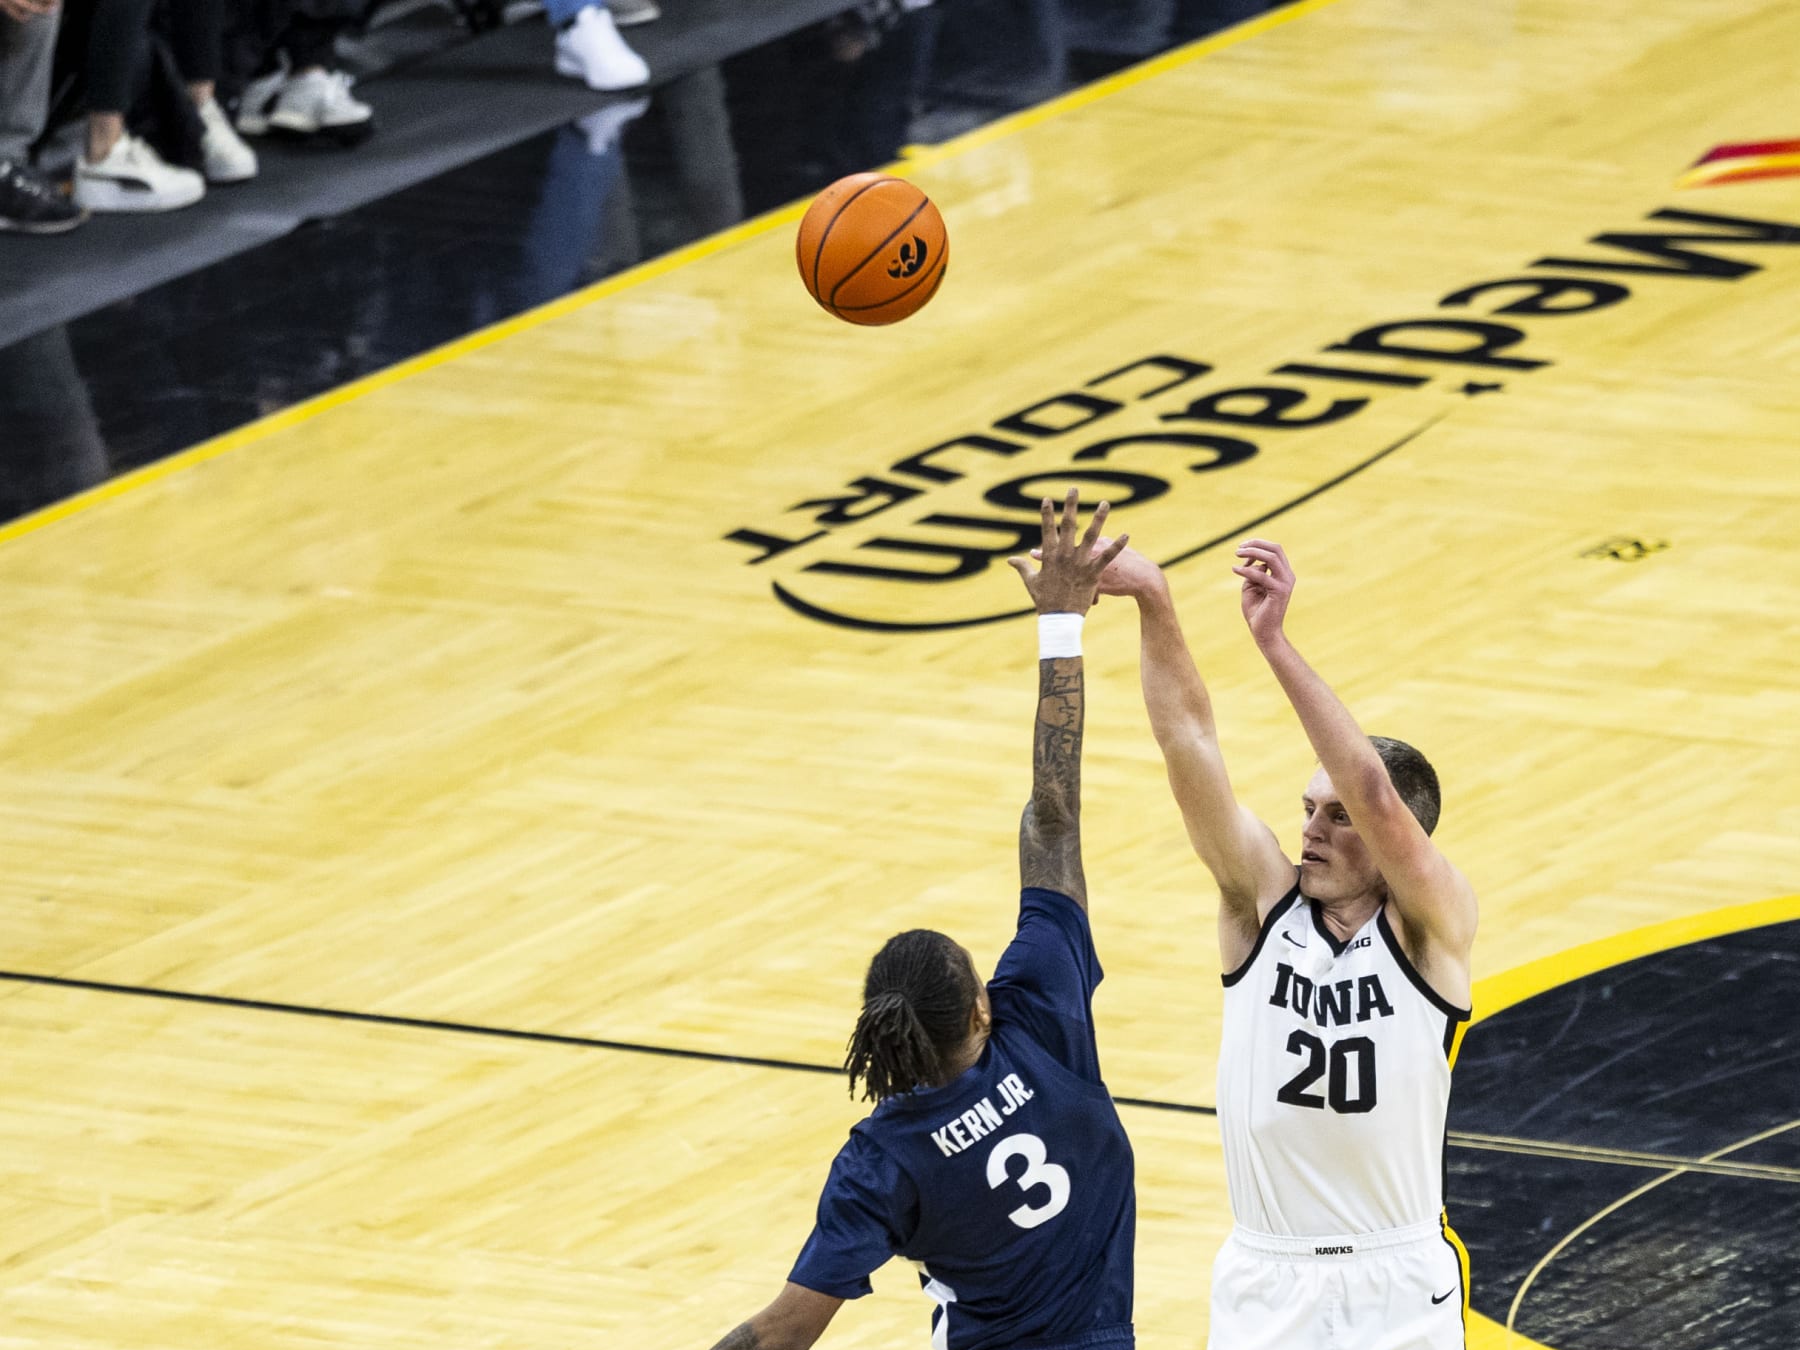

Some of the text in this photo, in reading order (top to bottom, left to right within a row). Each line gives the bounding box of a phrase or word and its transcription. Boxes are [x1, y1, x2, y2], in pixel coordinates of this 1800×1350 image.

[804, 208, 1800, 582] Mediacom
[724, 356, 1213, 564] COURT
[1269, 962, 1395, 1028] IOWA
[1277, 1029, 1377, 1114] 20
[930, 1073, 1035, 1158] KERN JR.
[986, 1133, 1071, 1229] 3
[1315, 1245, 1354, 1256] HAWKS
